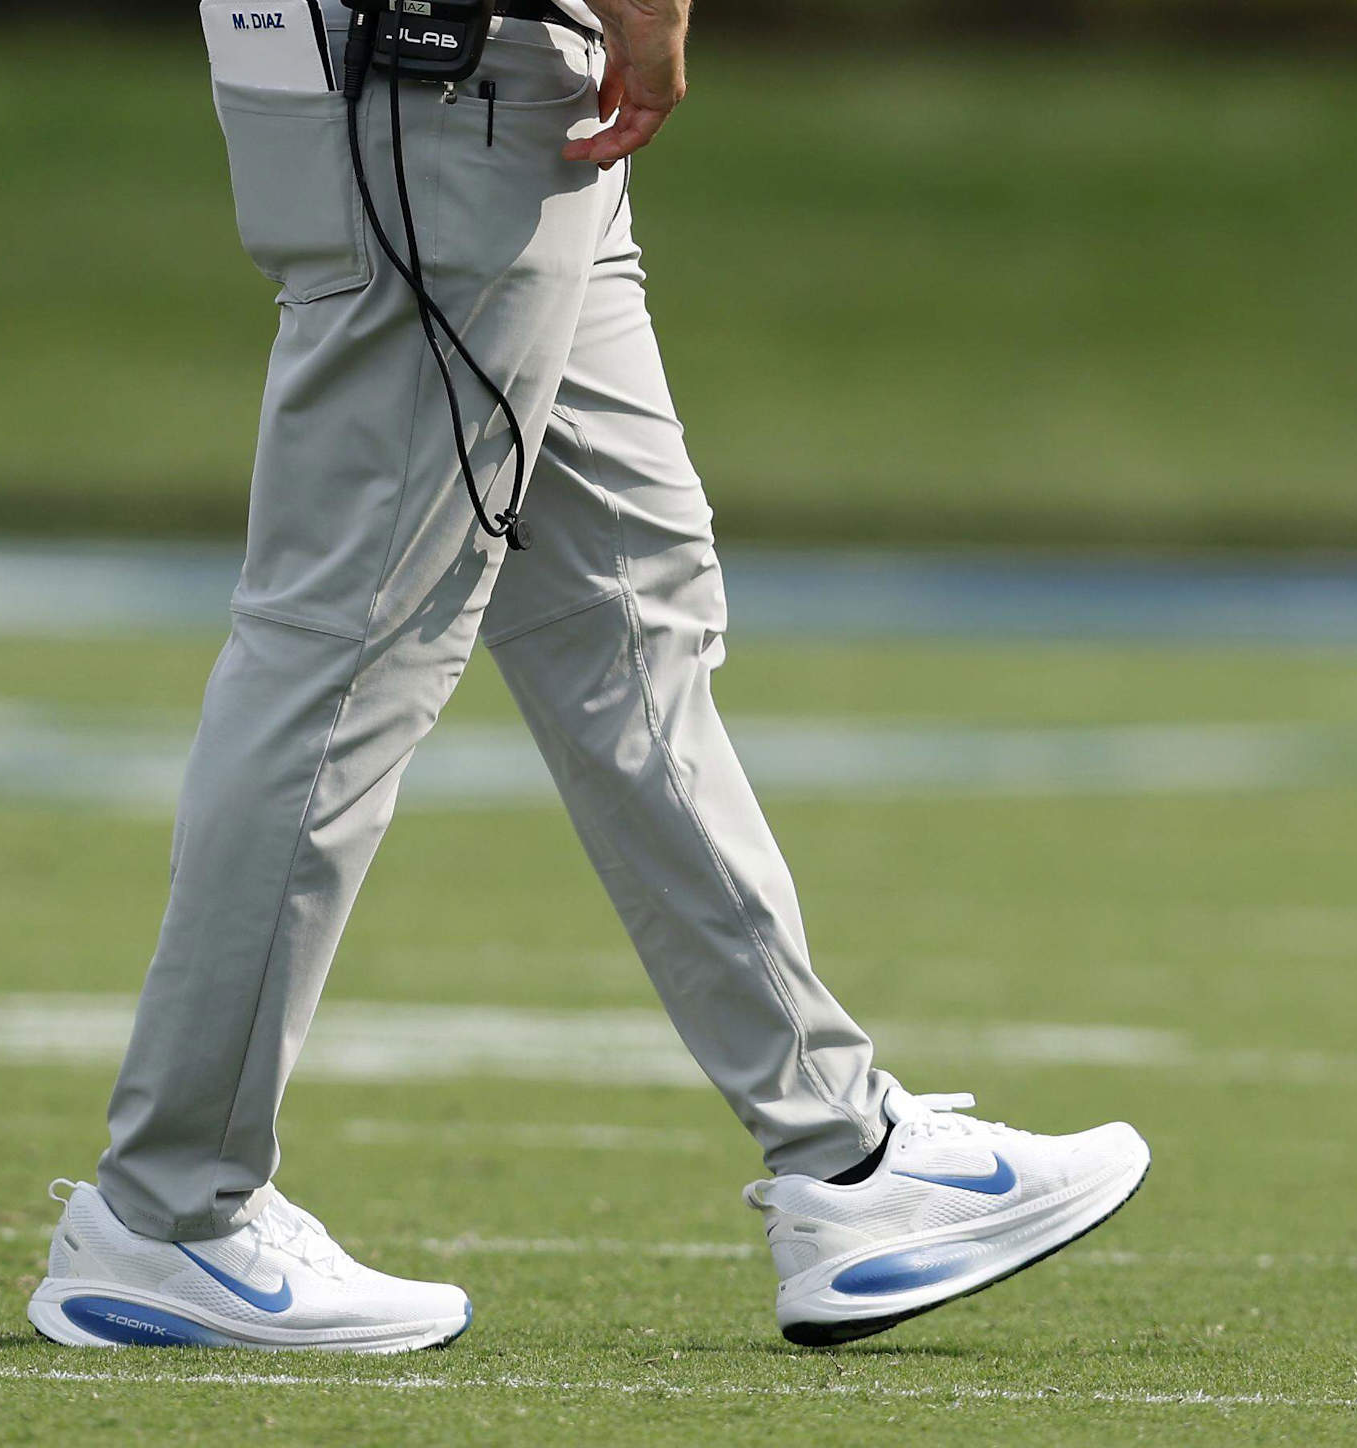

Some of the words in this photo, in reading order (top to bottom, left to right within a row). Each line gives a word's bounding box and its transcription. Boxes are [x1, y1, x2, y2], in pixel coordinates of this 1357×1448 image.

[396, 1, 426, 13] IAZ
[231, 13, 250, 30] M.
[250, 13, 285, 29] DIAZ
